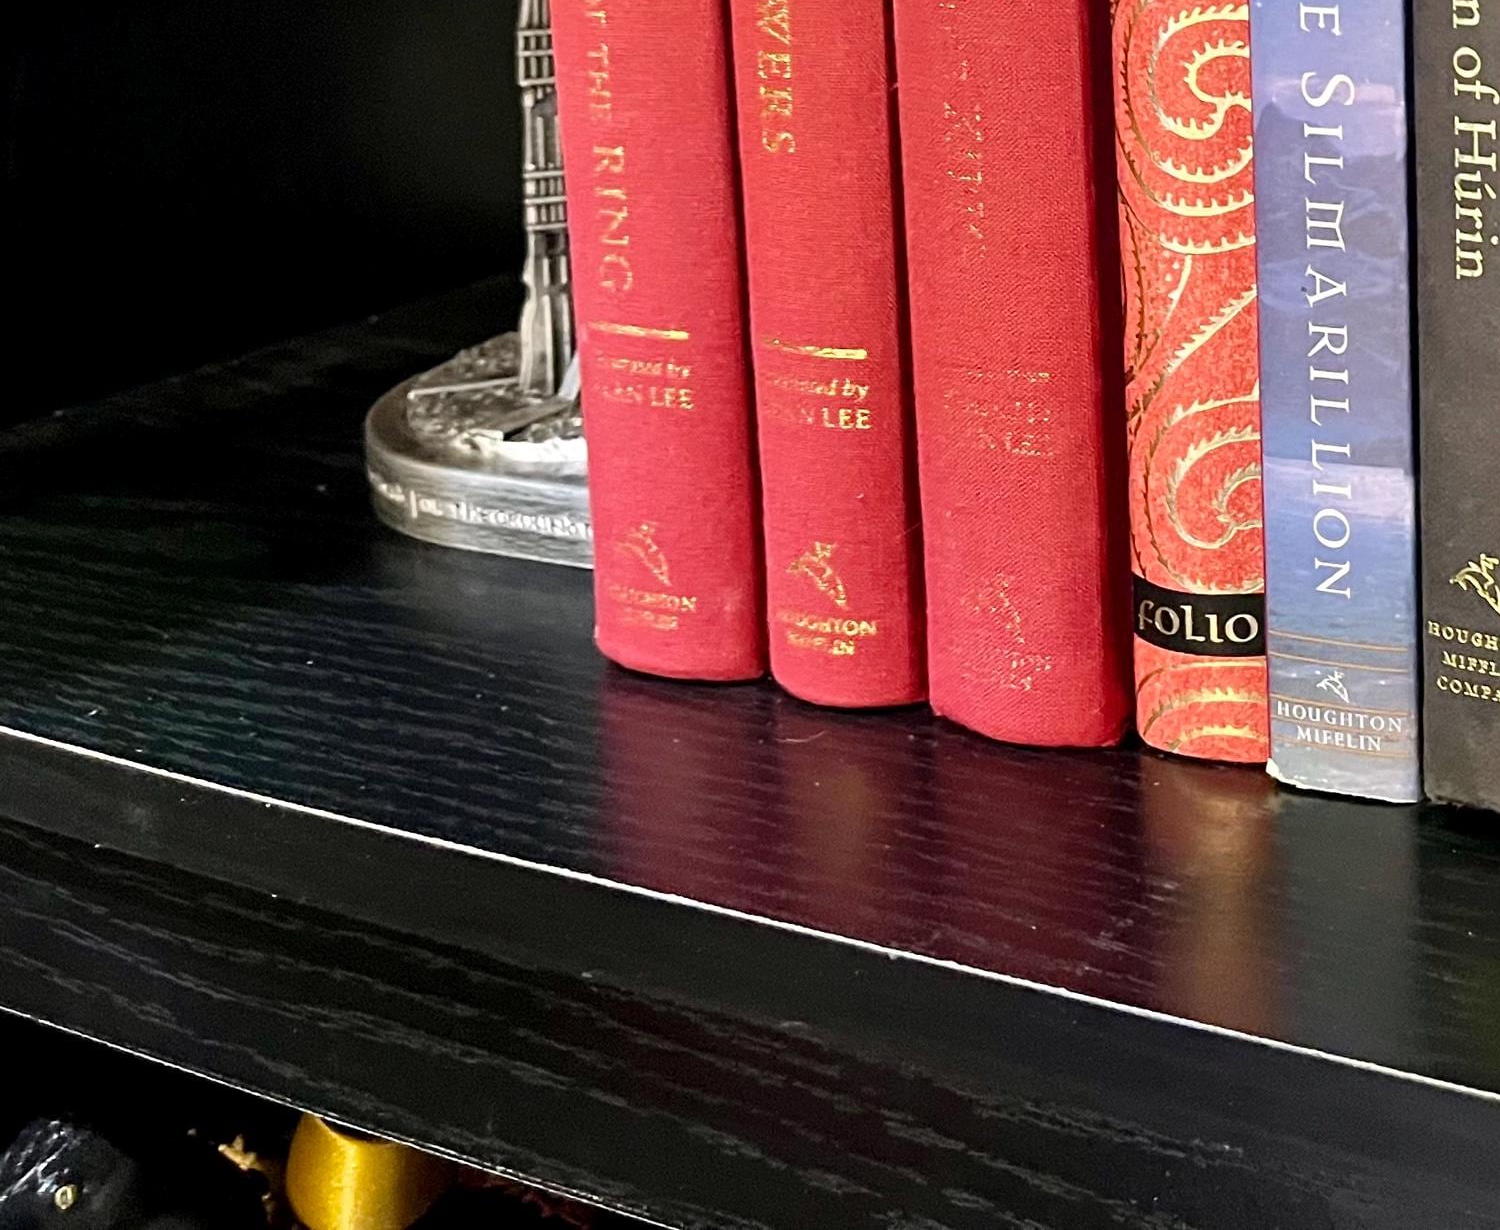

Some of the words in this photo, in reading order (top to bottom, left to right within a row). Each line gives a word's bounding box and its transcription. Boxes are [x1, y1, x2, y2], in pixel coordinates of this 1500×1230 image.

[1453, 47, 1500, 105] of
[1453, 115, 1499, 280] Húrin
[592, 145, 633, 293] RING
[1300, 71, 1356, 600] SILMARILLION
[648, 386, 696, 410] LEE
[842, 377, 869, 403] by
[822, 407, 872, 430] LEE
[1138, 599, 1259, 644] FOLIO
[1277, 701, 1402, 733] HOUGHTON
[1297, 725, 1381, 752] MIFFLIN
